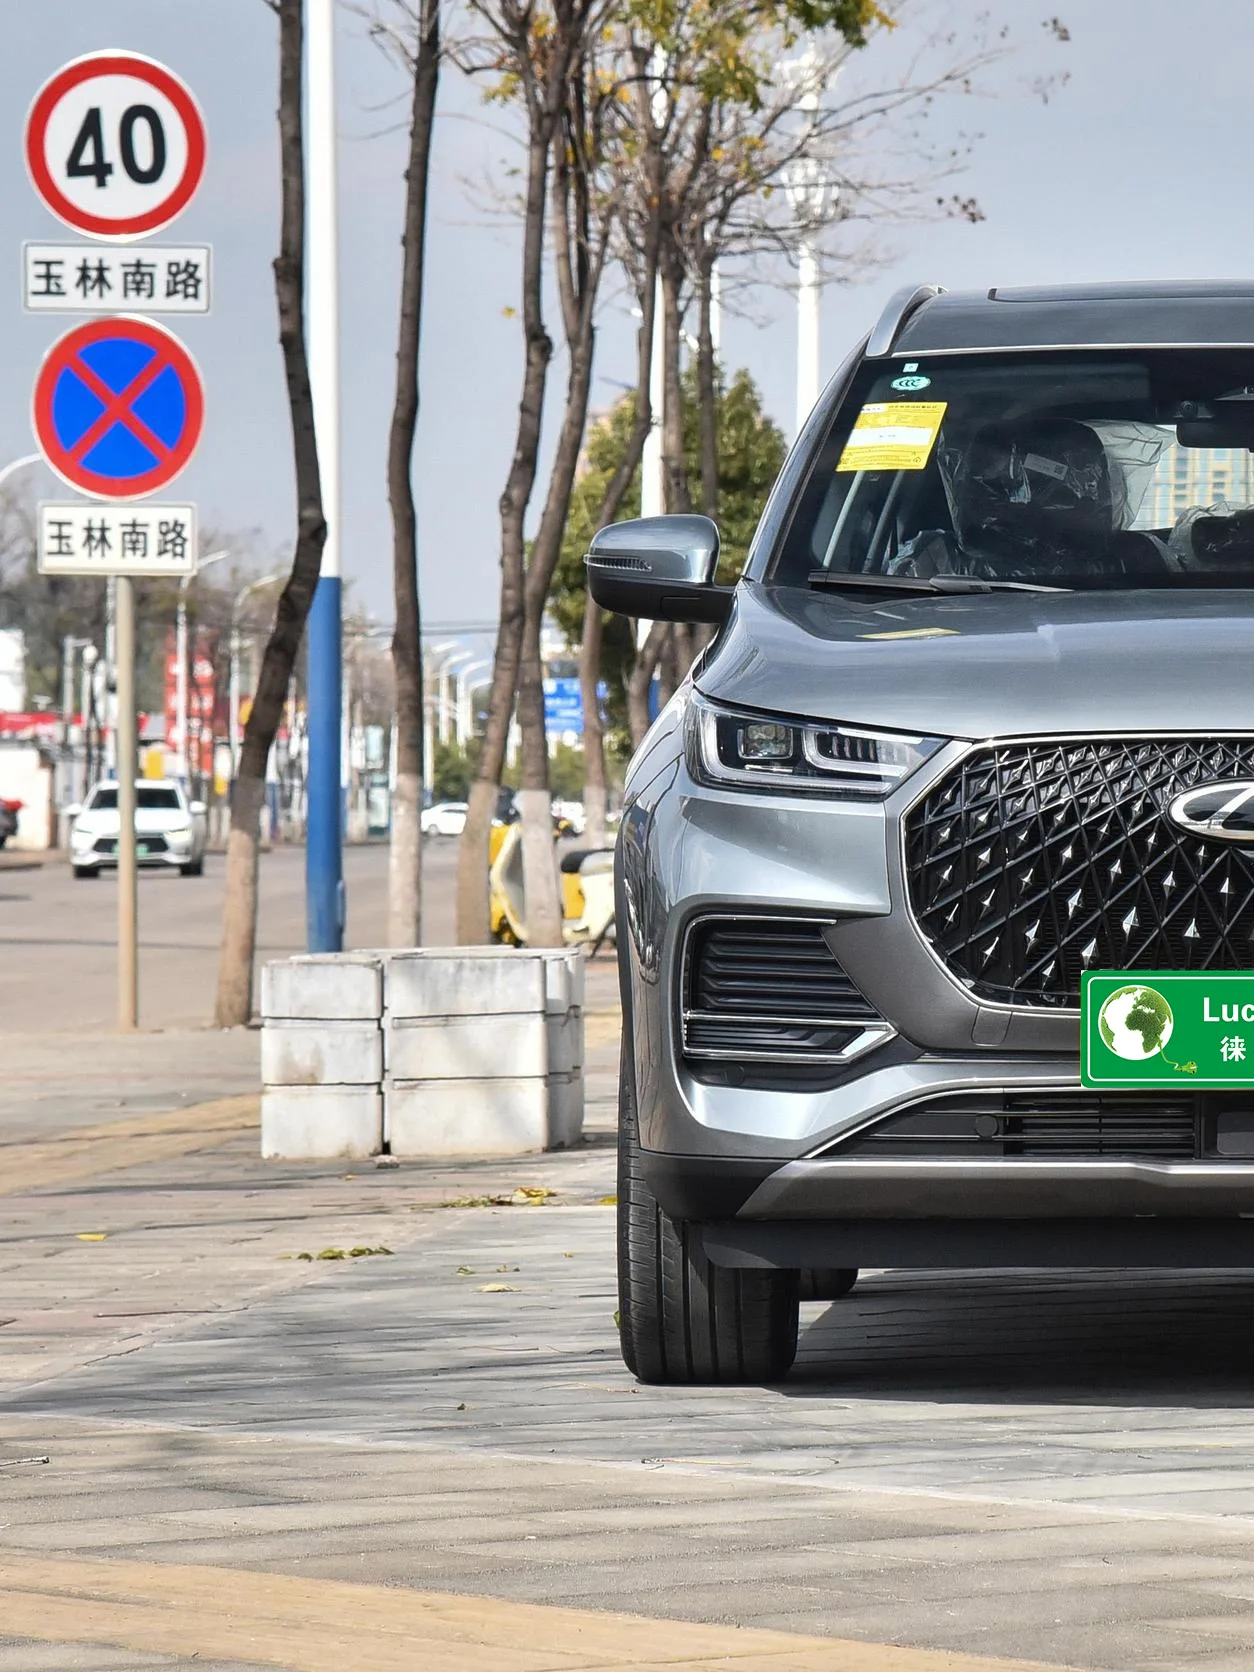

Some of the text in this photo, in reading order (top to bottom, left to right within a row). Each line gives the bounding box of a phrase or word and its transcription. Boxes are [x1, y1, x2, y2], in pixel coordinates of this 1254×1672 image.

[66, 104, 166, 188] 40
[31, 259, 202, 299] 玉林南路
[47, 520, 188, 559] 玉林南路
